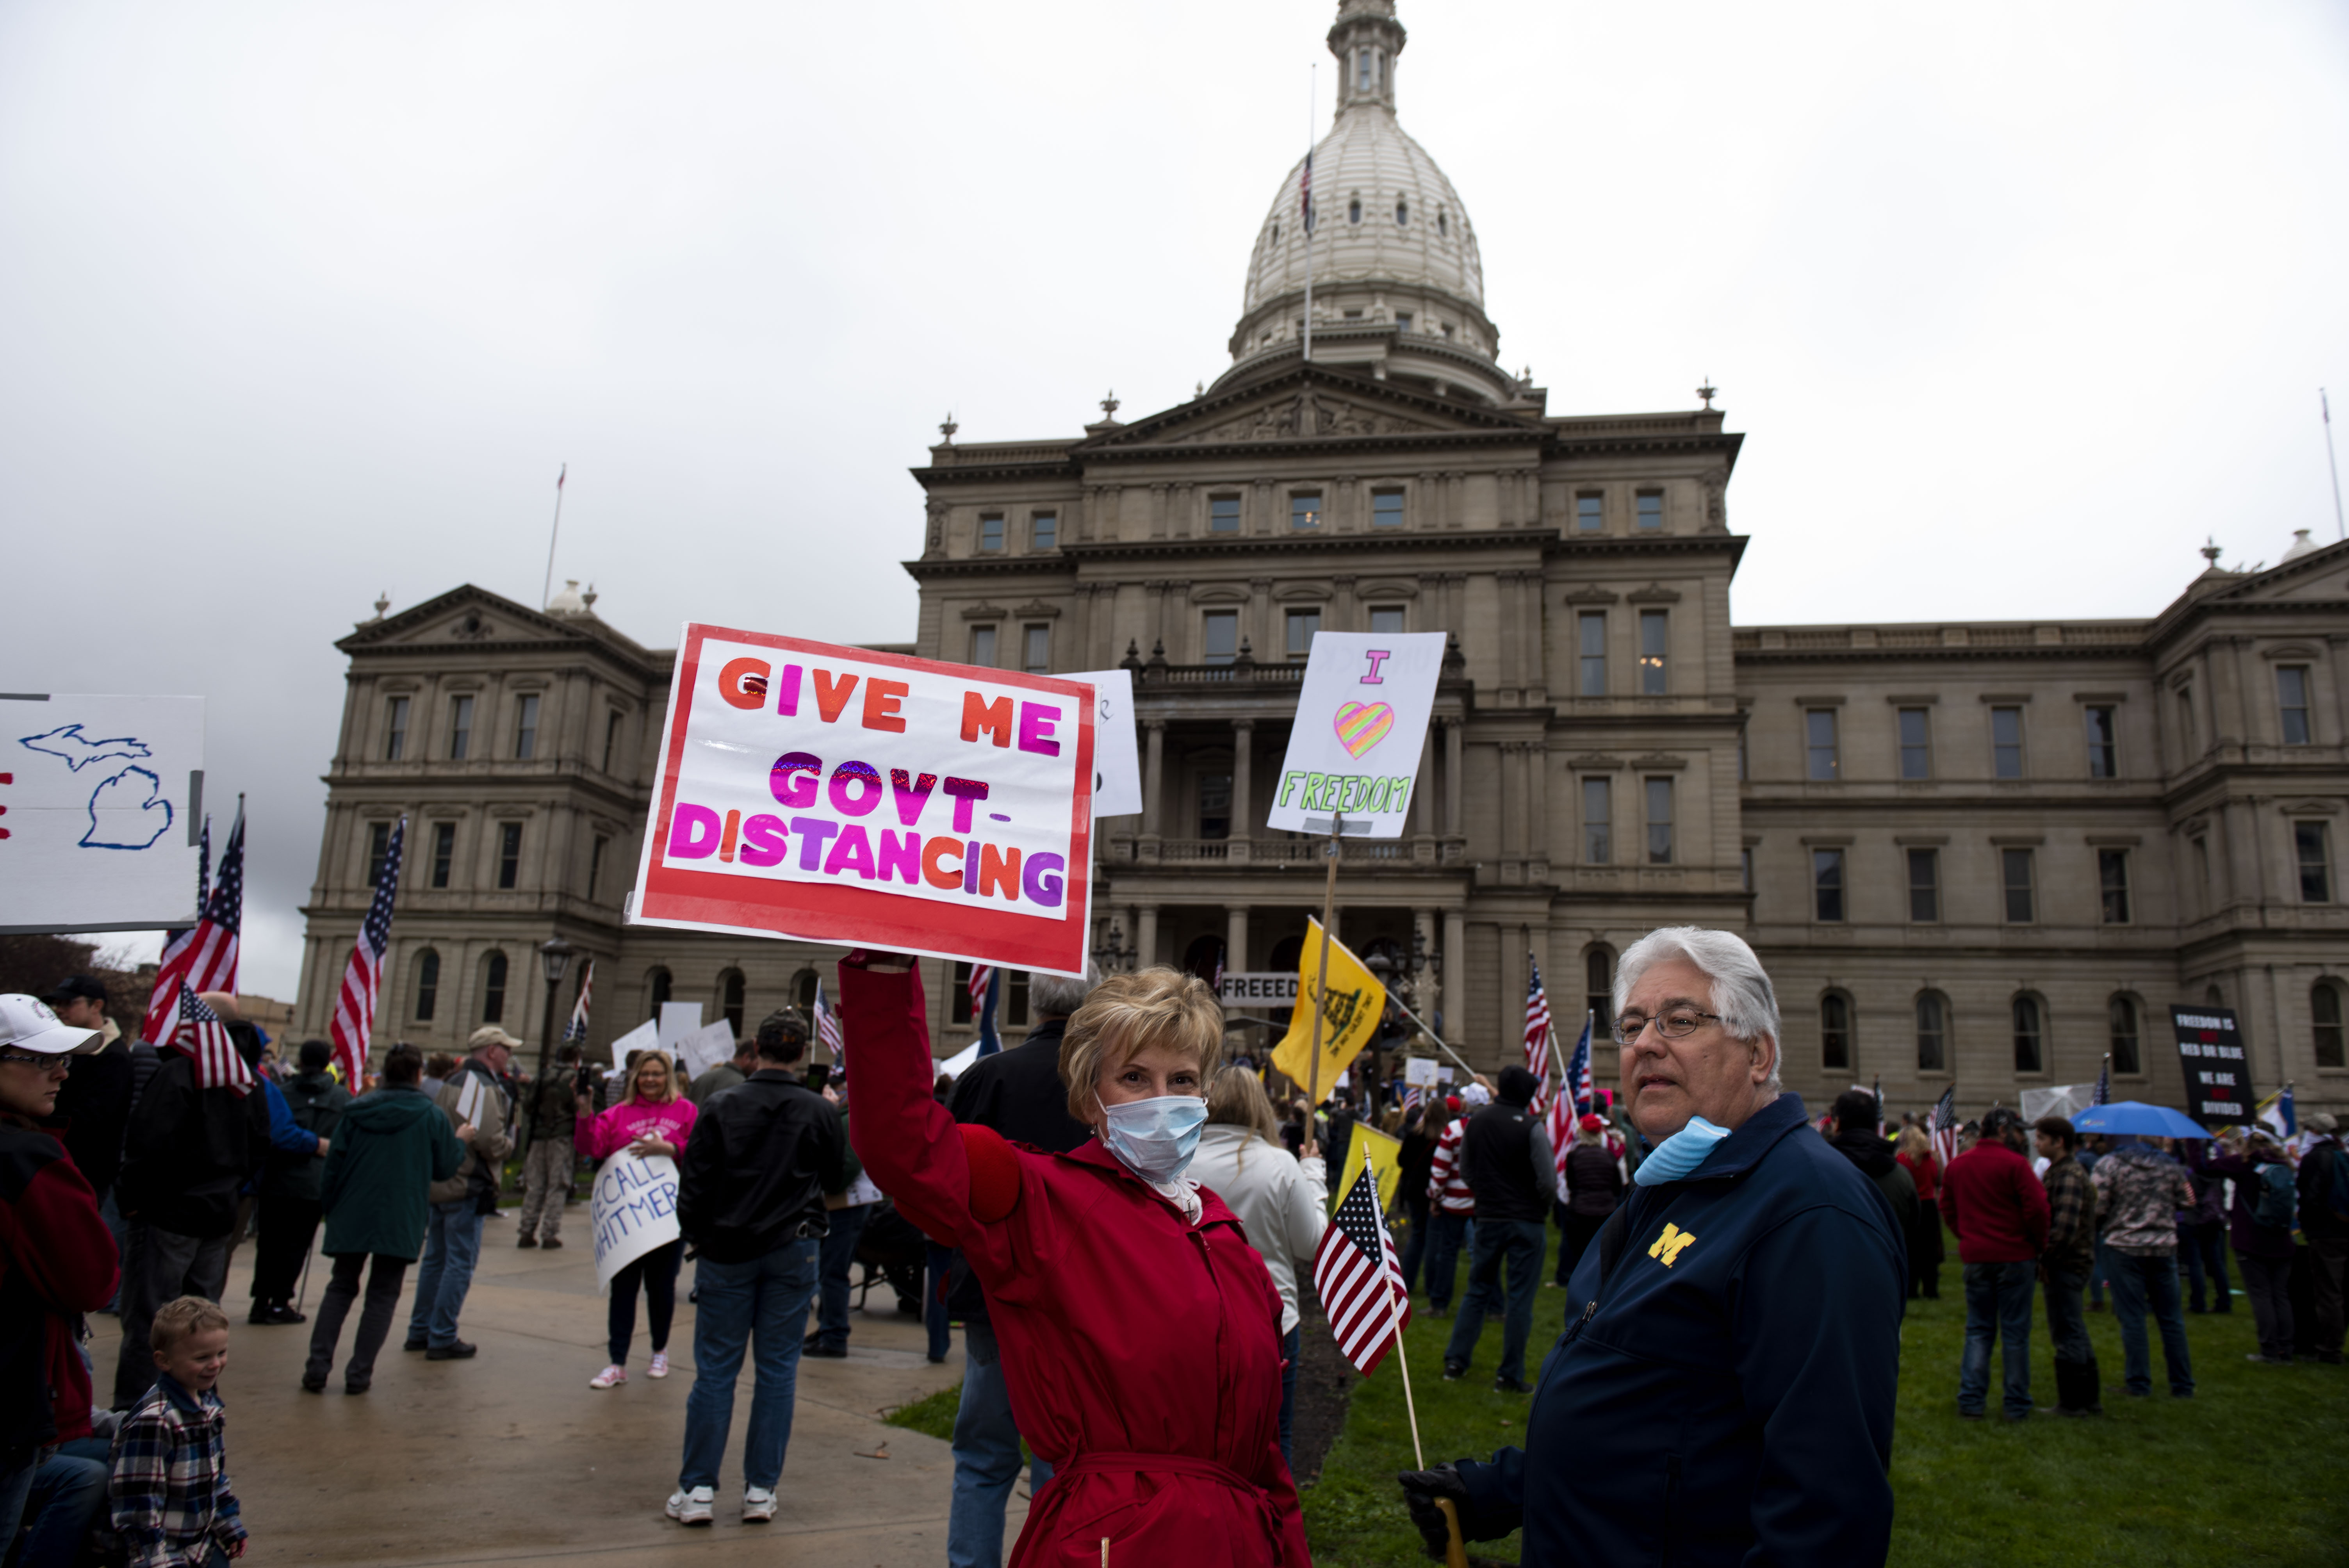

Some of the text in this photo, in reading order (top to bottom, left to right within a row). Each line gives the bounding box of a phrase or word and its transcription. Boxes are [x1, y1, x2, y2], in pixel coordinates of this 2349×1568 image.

[1360, 650, 1390, 684] I
[718, 657, 1061, 757] GIVE ME
[769, 752, 1011, 834] GOVT-
[1279, 771, 1410, 813] FREEDOM
[668, 802, 1064, 907] DISTANCING
[1647, 1222, 1696, 1266] M
